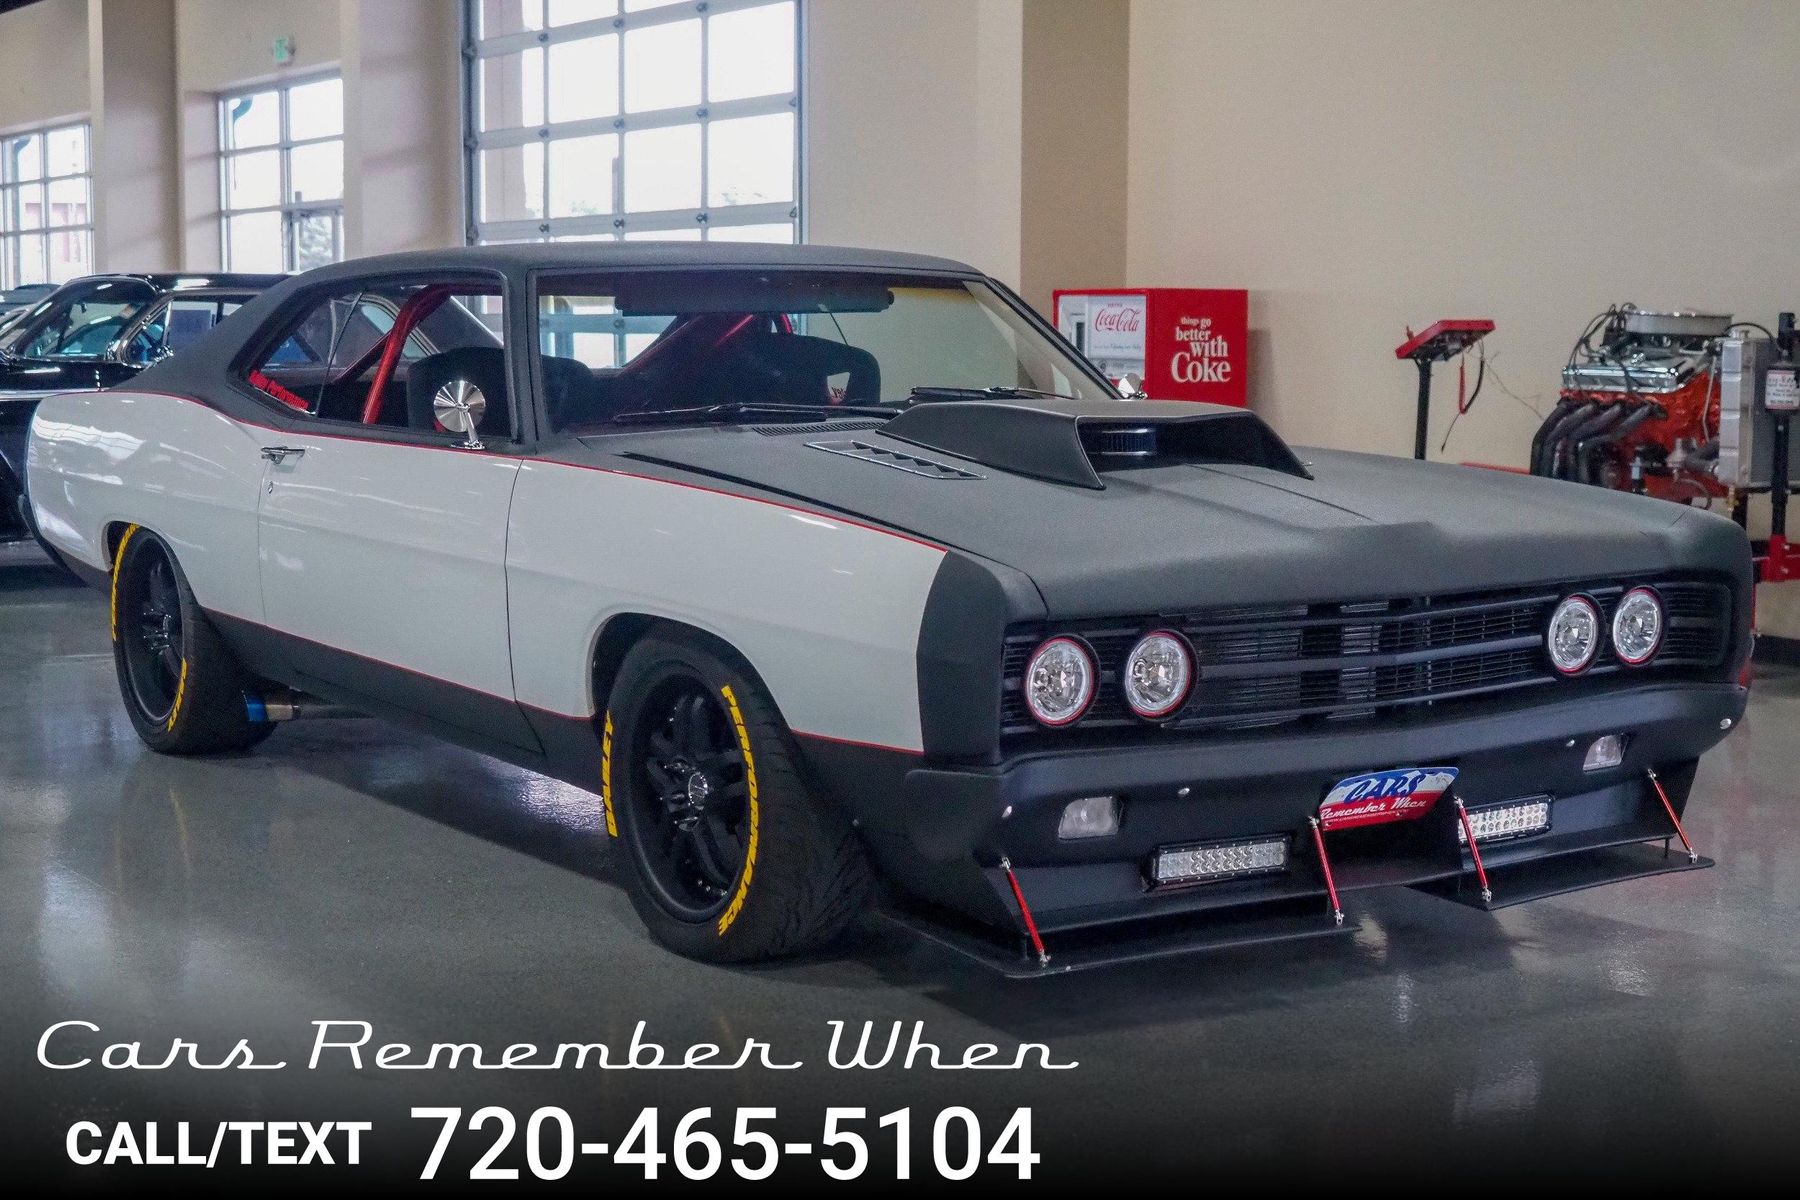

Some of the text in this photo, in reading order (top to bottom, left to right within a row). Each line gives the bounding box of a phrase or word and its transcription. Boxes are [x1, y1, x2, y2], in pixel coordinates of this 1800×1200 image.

[1175, 326, 1211, 341] better
[1200, 318, 1212, 329] go
[1190, 335, 1229, 357] with
[1171, 352, 1232, 382] Coke
[1344, 773, 1427, 803] CARS
[720, 684, 759, 936] PERFORMANCE
[1320, 802, 1386, 819] Remember
[1391, 797, 1426, 810] When
